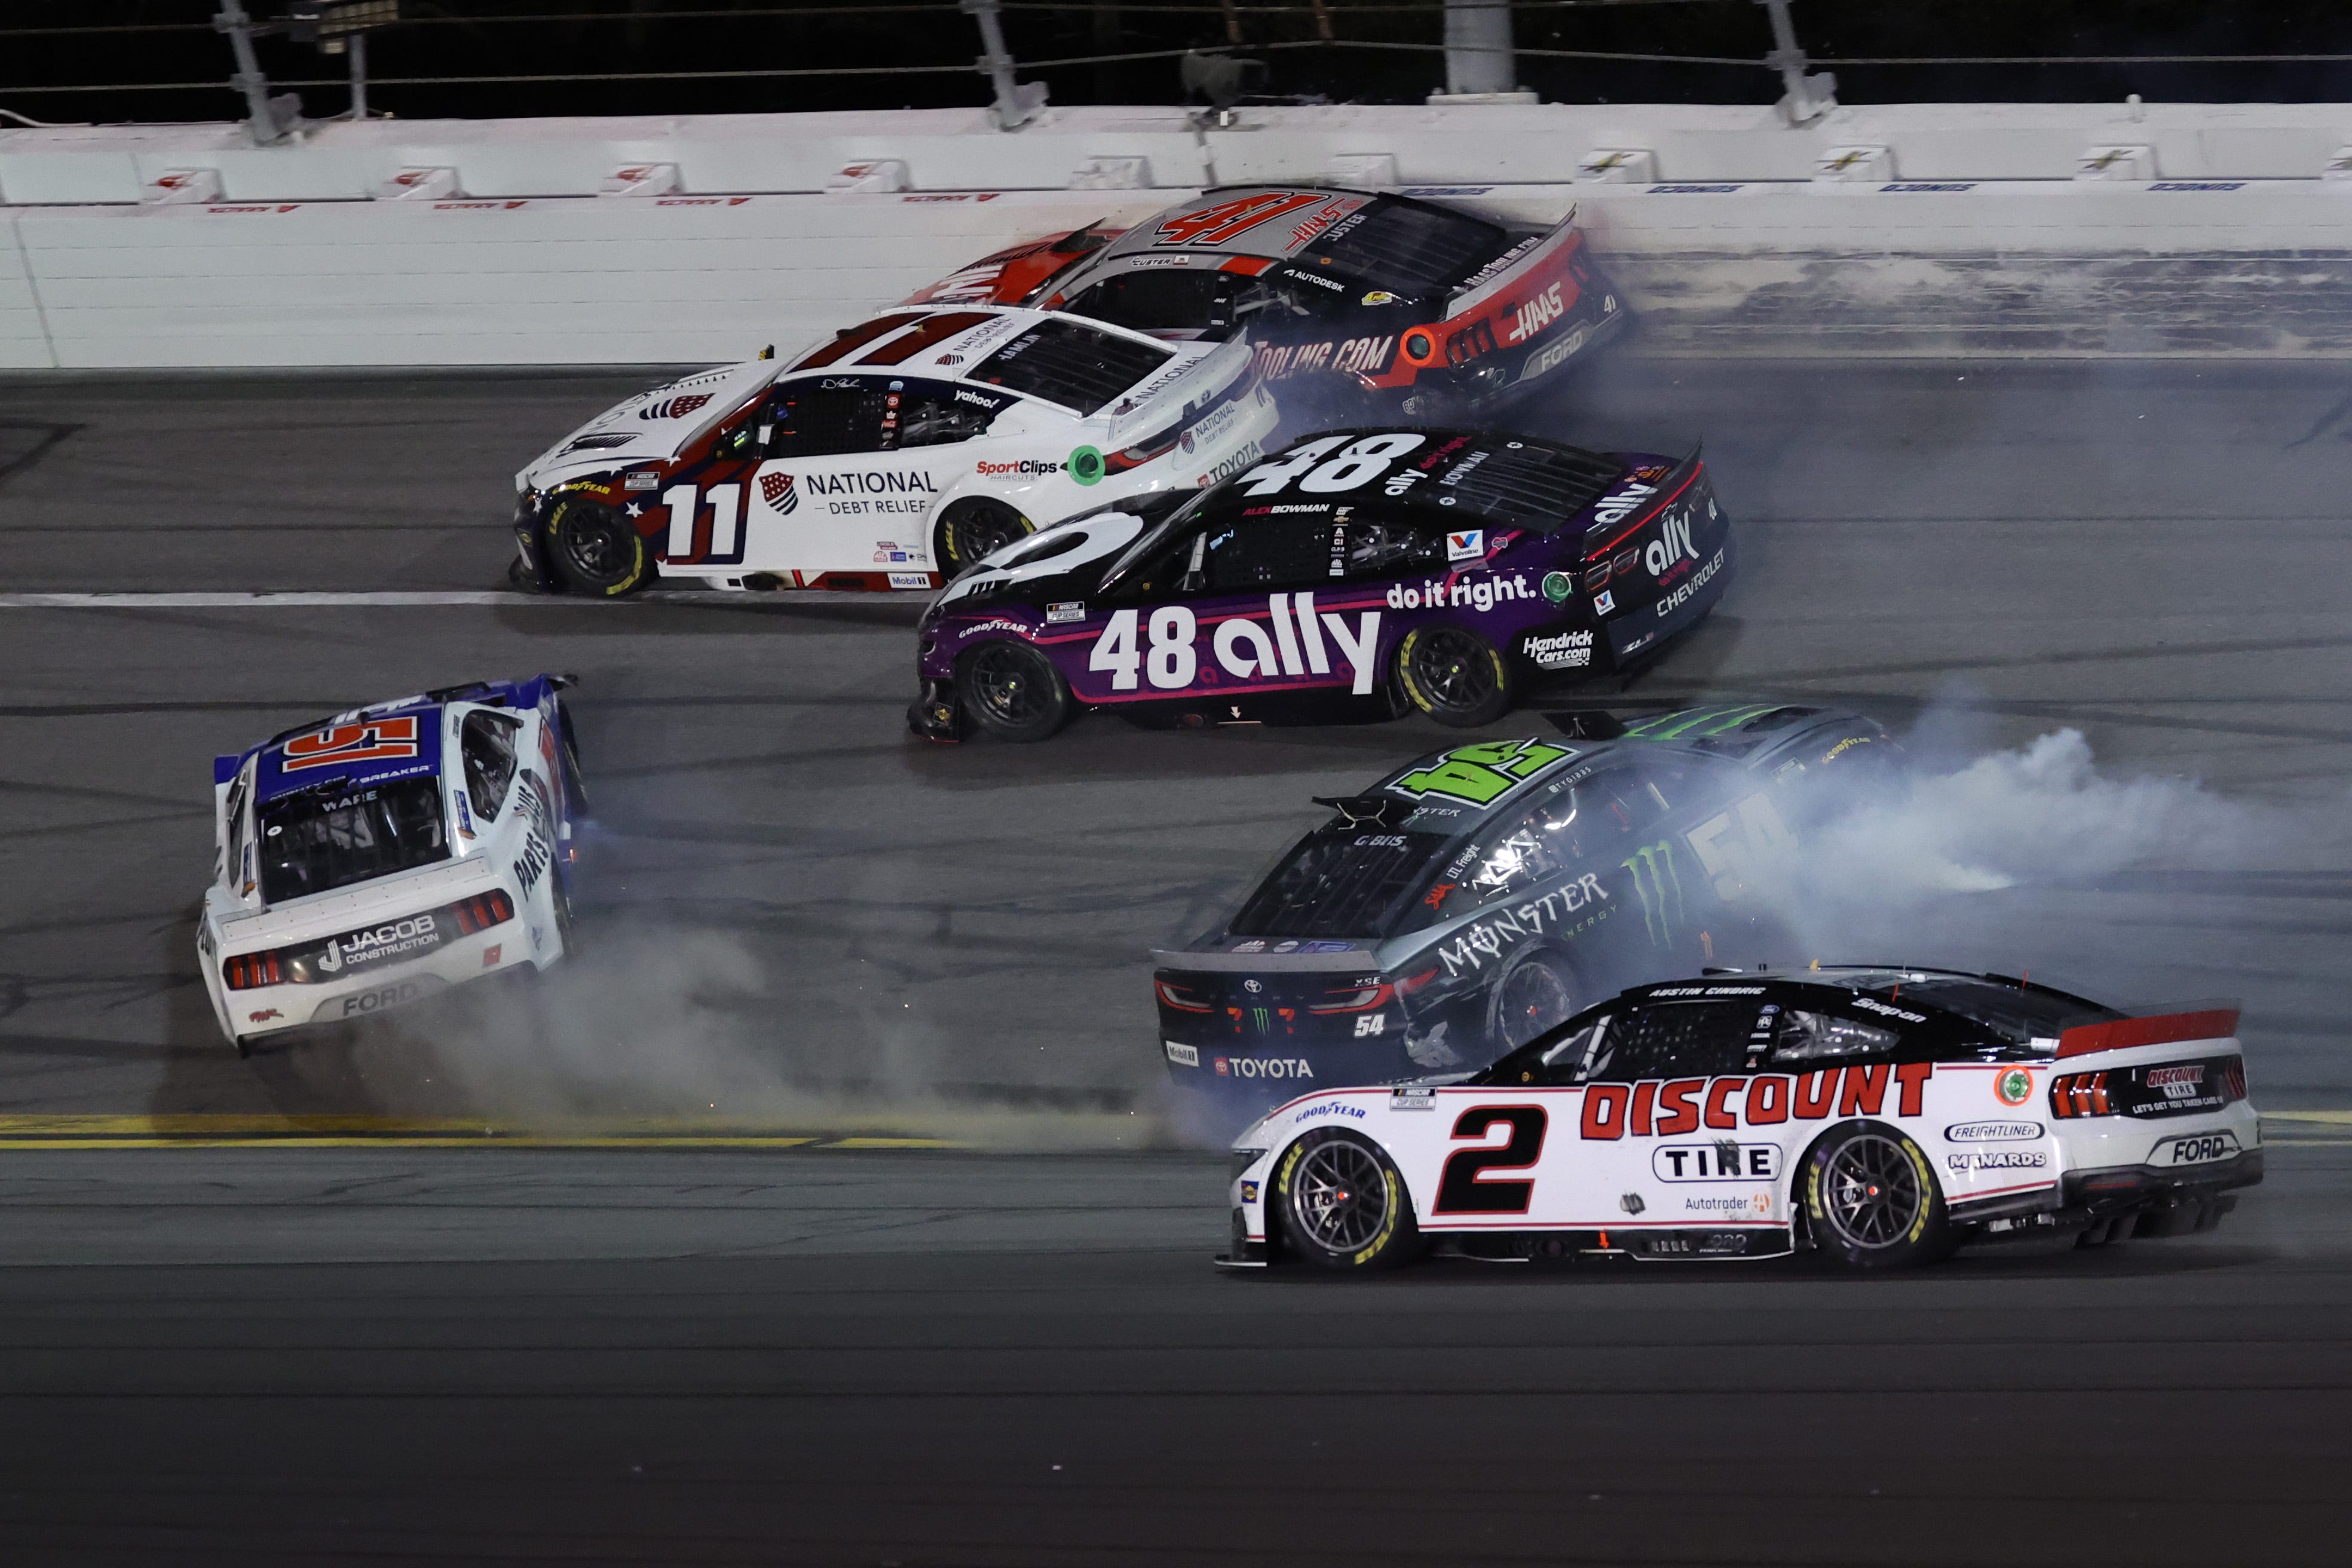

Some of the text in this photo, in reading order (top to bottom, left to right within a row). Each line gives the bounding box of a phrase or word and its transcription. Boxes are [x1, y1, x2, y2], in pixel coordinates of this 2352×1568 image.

[1153, 191, 1330, 246] 41
[1295, 271, 1345, 292] AUTODESK
[1509, 281, 1564, 341] HAAS
[786, 311, 1005, 375] 11
[953, 318, 1011, 351] NATIONAL
[1541, 330, 1582, 372] FORD
[1135, 356, 1206, 399] NATIONAL
[954, 389, 1000, 409] yahoo!
[1195, 403, 1235, 439] NATIONAL
[976, 461, 1058, 476] SportClips
[1209, 440, 1260, 485] TOYOTA
[1234, 433, 1426, 497] 48
[807, 471, 938, 495] NATIONAL
[1385, 468, 1428, 495] ally
[829, 500, 927, 514] DEBT RELIEF
[1270, 504, 1330, 514] BOWMAN
[1594, 483, 1658, 518] ally
[662, 483, 740, 557] 11
[1451, 549, 1478, 558] Valvoline
[1646, 510, 1699, 576] ally
[892, 576, 917, 586] Mobil
[1386, 574, 1537, 612] do it right.
[1656, 547, 1724, 617] CHEVROLET
[958, 619, 1028, 639] GOODYEAR
[1214, 589, 1382, 695] ally
[1523, 629, 1594, 659] Hendrick
[1089, 606, 1196, 690] 48
[1536, 648, 1591, 664] Cars.com
[283, 715, 418, 773] 51
[360, 765, 430, 783] BREAKER
[1384, 739, 1582, 810] 54
[513, 832, 549, 902] PARTS
[1446, 867, 1463, 879] LTL
[1456, 844, 1481, 868] Freight
[342, 914, 435, 954] JACOB
[1438, 872, 1609, 976] MONSTER
[346, 932, 440, 965] CONSTRUCTION
[1354, 976, 1380, 987] XSE
[1649, 987, 1766, 997] AUSTIN CINDRIC
[342, 984, 419, 1017] FORD
[1851, 997, 1927, 1023] Snap-on
[1353, 1013, 1385, 1039] 54
[1229, 1058, 1313, 1079] TOYOTA
[2147, 1065, 2204, 1088] DISCOUNT
[1579, 1062, 1933, 1140] DISCOUNT
[2167, 1085, 2192, 1096] TIRE
[1296, 1101, 1366, 1123] GOODYEAR
[2133, 1103, 2154, 1114] LET'S
[2168, 1100, 2182, 1108] YOU
[1955, 1125, 2035, 1138] FREIGHTLINER
[1431, 1103, 1549, 1217] 2
[1948, 1152, 2047, 1169] MENARDS
[2173, 1137, 2224, 1163] FORD
[1686, 1196, 1748, 1211] Autotrader
